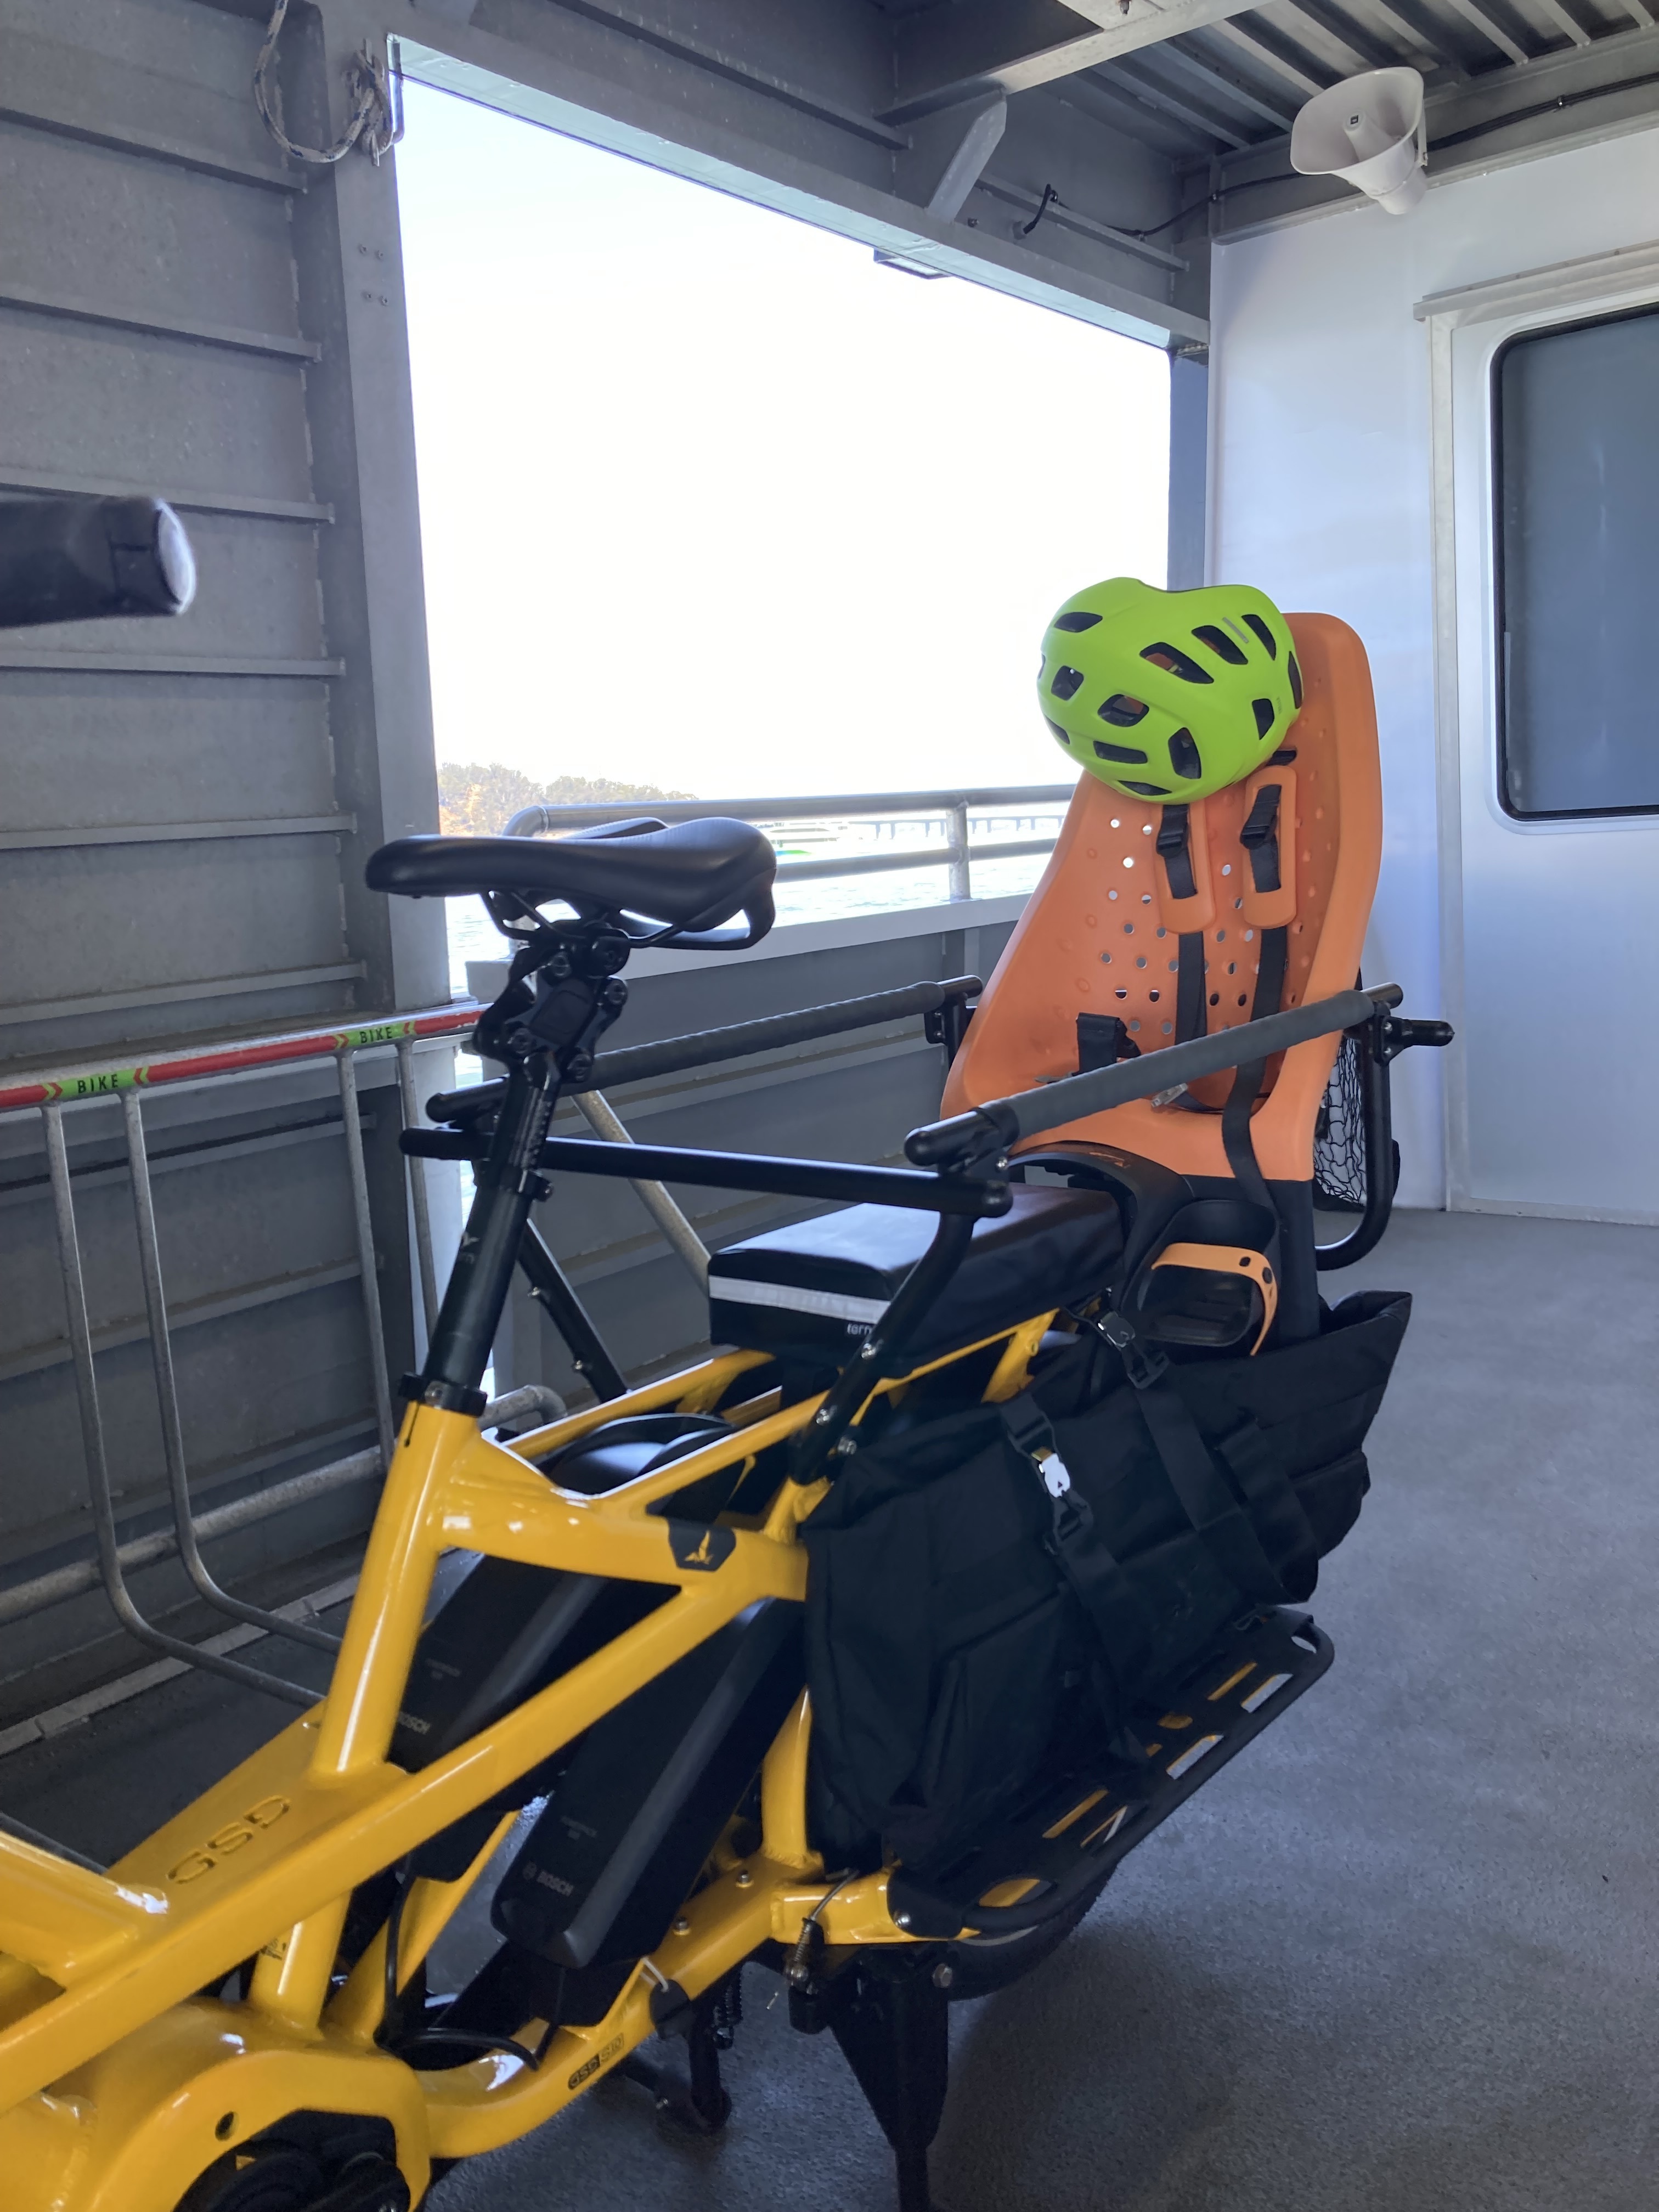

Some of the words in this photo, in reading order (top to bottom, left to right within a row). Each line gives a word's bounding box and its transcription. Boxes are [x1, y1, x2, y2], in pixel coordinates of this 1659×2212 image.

[360, 1027, 392, 1043] BIKE
[78, 1074, 119, 1093] BIKE
[166, 1795, 291, 1884] GSD
[537, 1870, 574, 1896] BOSCH
